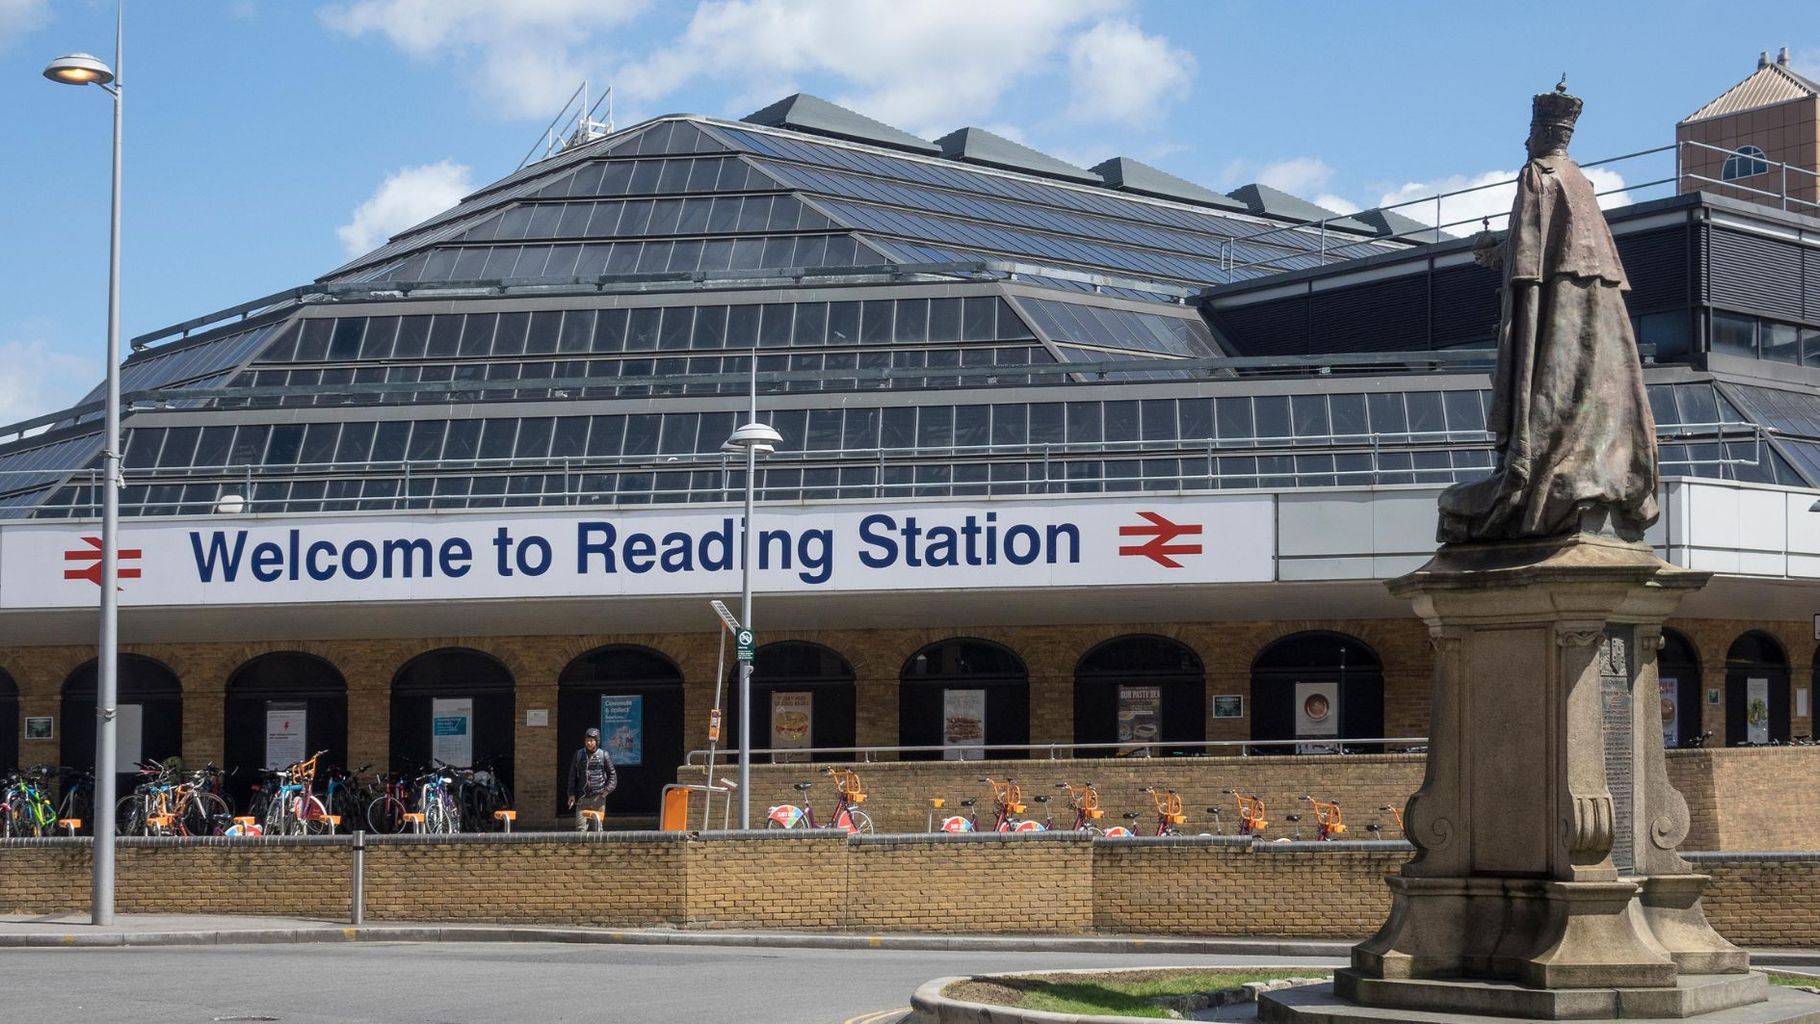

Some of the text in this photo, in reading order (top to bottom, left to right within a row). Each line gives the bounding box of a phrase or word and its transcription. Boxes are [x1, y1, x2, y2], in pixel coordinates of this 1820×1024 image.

[190, 529, 473, 583] Welcome
[493, 526, 553, 577] to
[859, 511, 1080, 569] Station
